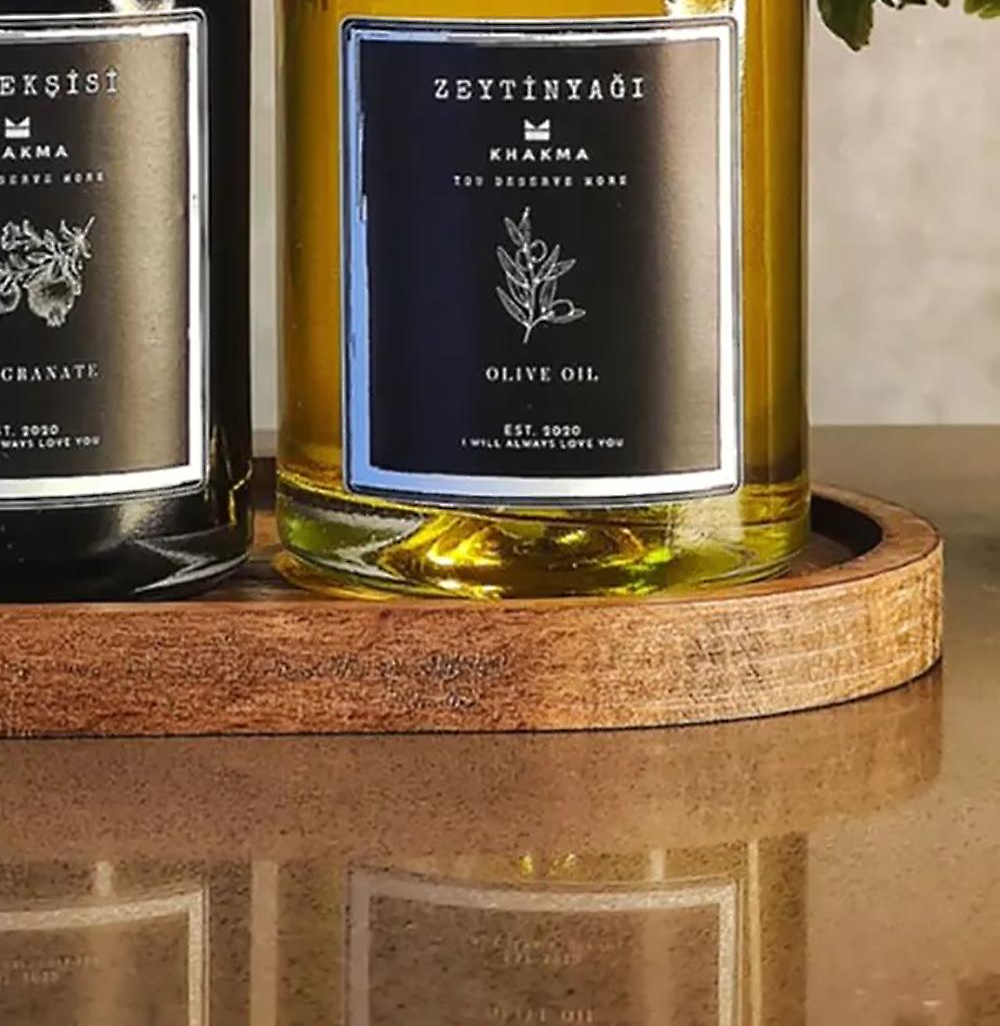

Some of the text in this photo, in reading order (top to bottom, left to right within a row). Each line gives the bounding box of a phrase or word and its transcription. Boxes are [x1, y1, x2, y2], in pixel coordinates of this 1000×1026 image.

[433, 72, 644, 102] ZEYTİNYAĞI
[489, 147, 590, 162] KHAKMA
[485, 365, 600, 383] OLIVE OIL
[21, 424, 60, 436] 2020
[503, 424, 582, 437] EST. 2020
[38, 437, 71, 448] LOVE
[75, 435, 101, 446] YOU
[471, 438, 502, 449] WILL
[505, 438, 556, 449] ALWAYS
[559, 438, 594, 449] LOVE
[597, 437, 625, 448] YOU
